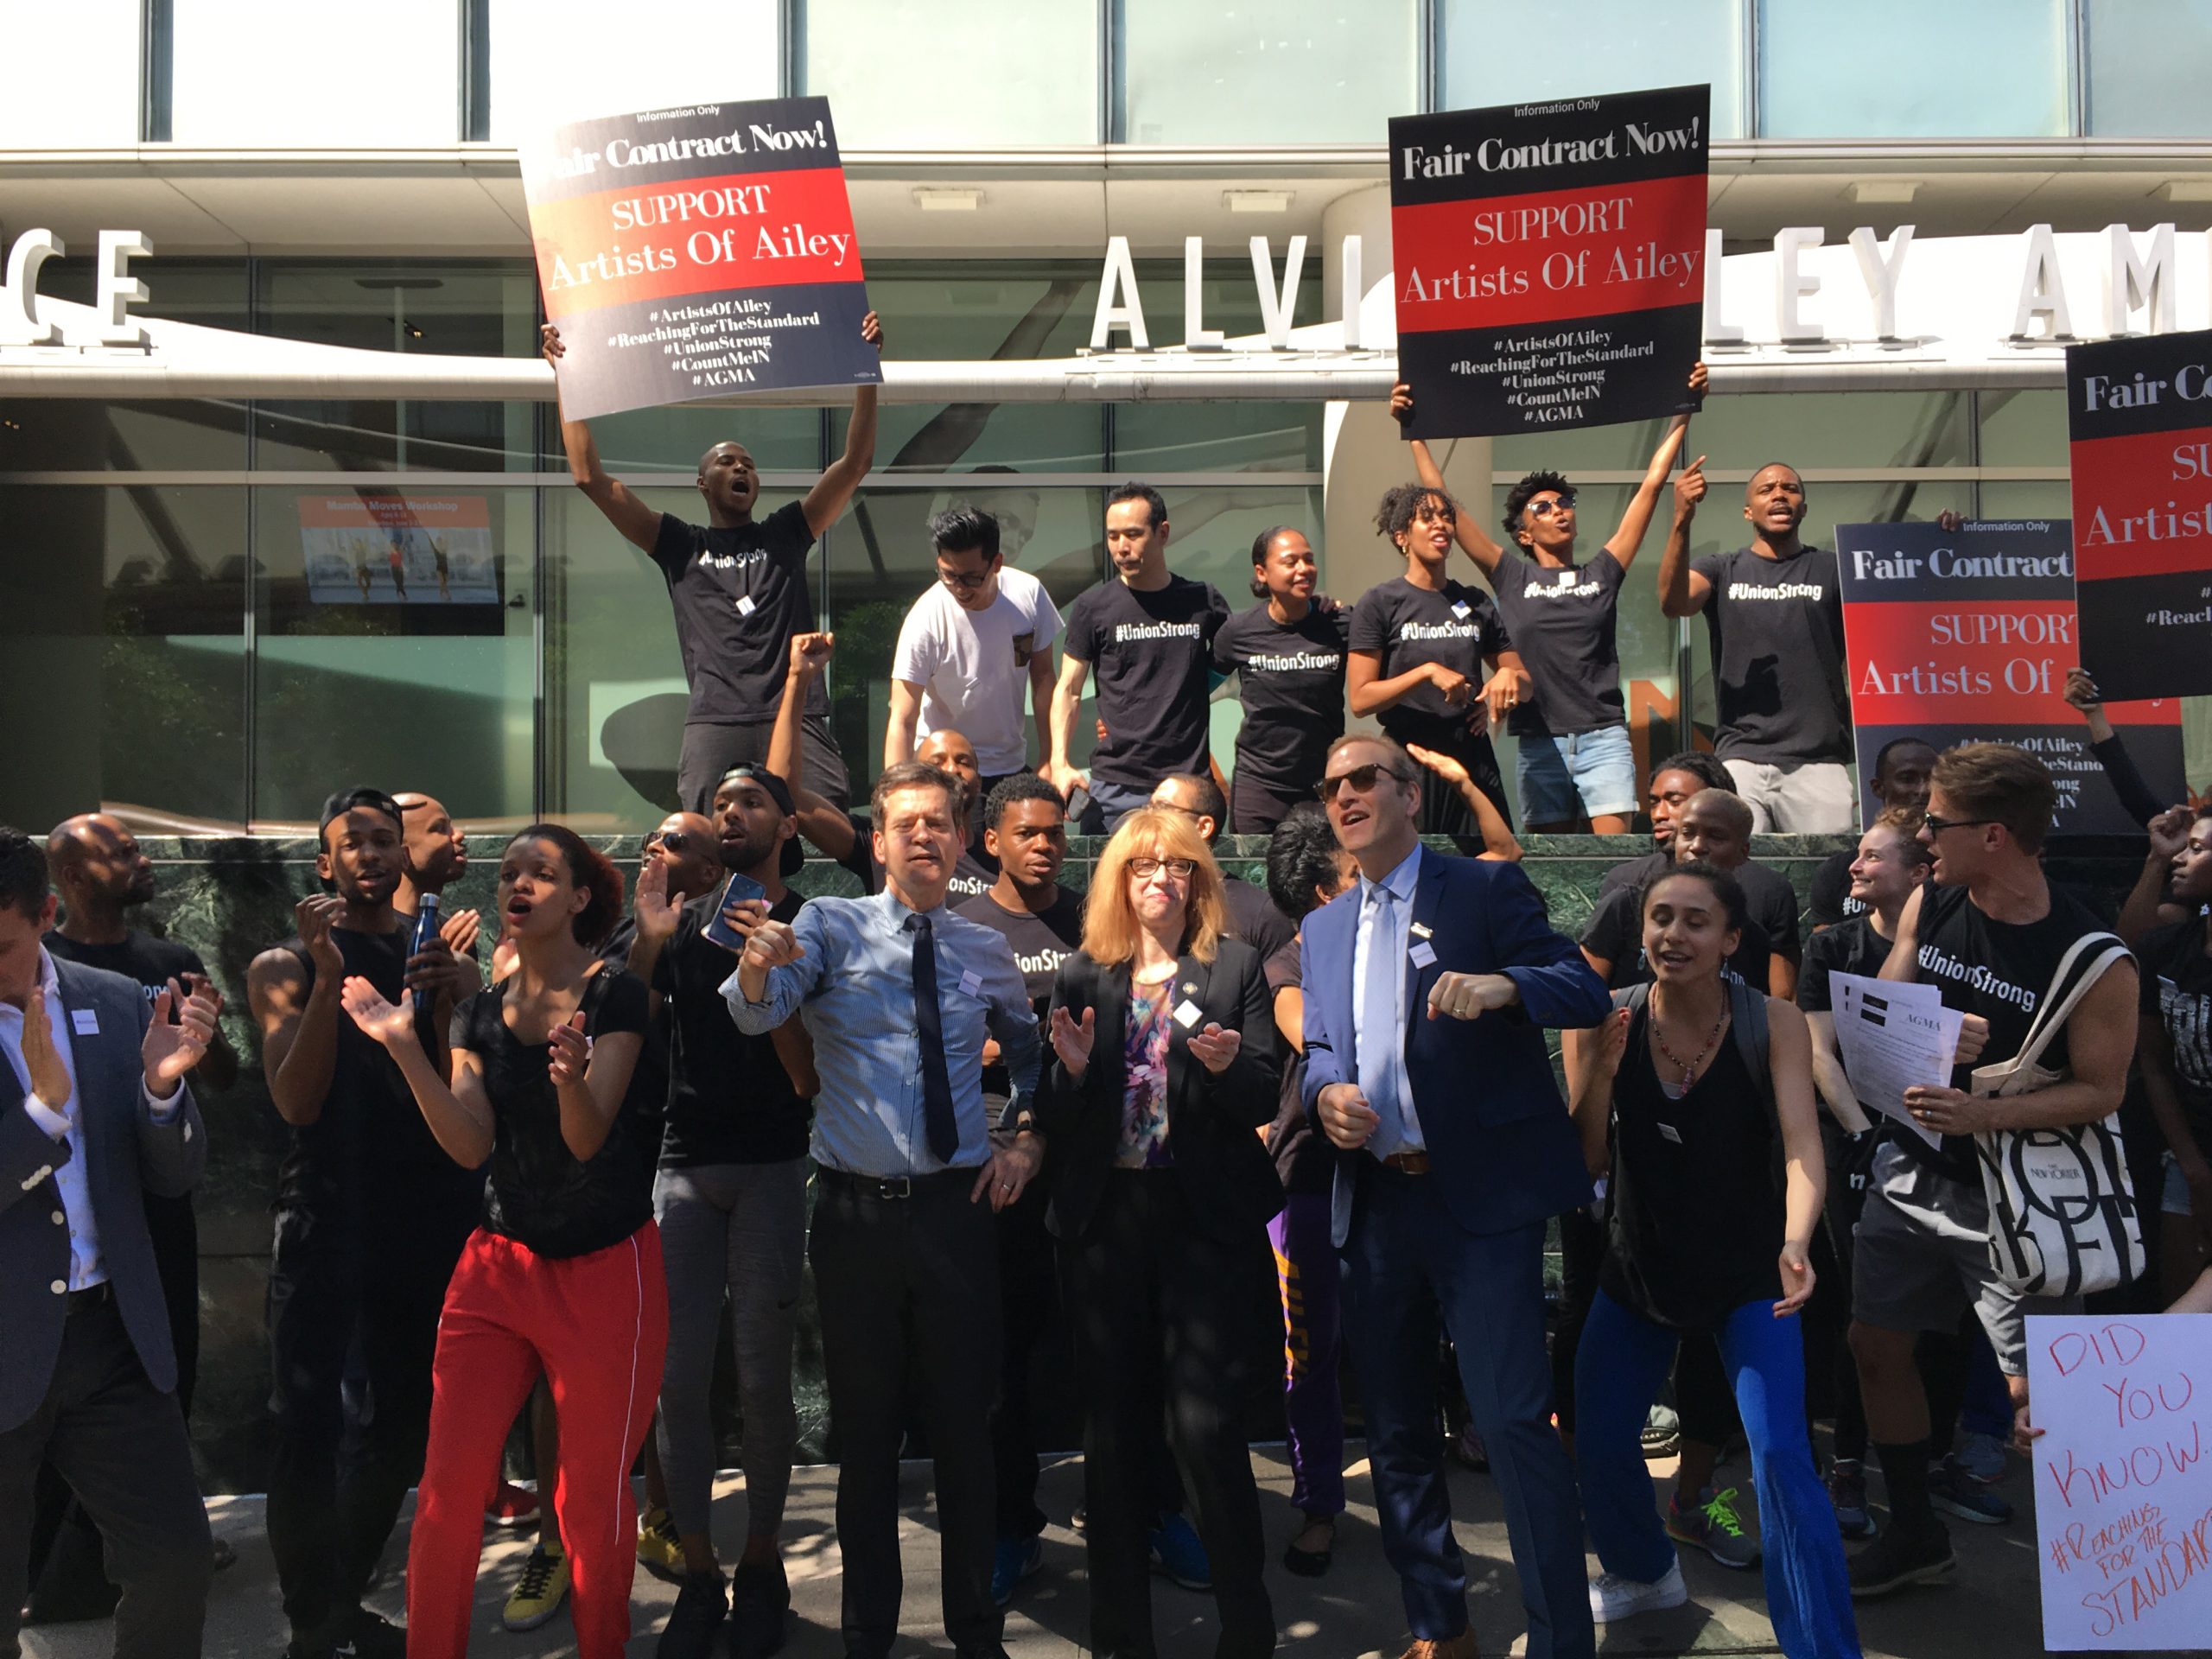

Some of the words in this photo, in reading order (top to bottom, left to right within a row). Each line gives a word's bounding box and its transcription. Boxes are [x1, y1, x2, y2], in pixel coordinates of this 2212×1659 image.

[636, 105, 696, 123] Information
[696, 104, 720, 118] Only
[1514, 100, 1575, 118] Information
[1577, 98, 1600, 113] Only
[544, 146, 601, 180] air
[606, 127, 747, 168] Contract
[749, 120, 829, 154] Now!
[1402, 143, 1471, 181] Fair
[1477, 130, 1619, 174] Contract
[1625, 115, 1700, 158] Now!
[610, 184, 771, 231] SUPPORT
[1473, 197, 1634, 245] SUPPORT
[548, 245, 677, 292] Artists
[686, 228, 735, 265] Of
[751, 223, 851, 266] Ailey
[1400, 263, 1529, 303] Artists
[1542, 249, 1591, 290] Of
[1601, 241, 1701, 288] Ailey
[1090, 234, 1362, 350] ALVI
[1703, 225, 1916, 345] LEY
[2010, 222, 2212, 340] AM
[649, 299, 772, 322] #ArtistsOfAiley
[607, 312, 820, 349] #ReachingForTheStandard
[664, 335, 772, 357] #UnionStrong
[1494, 329, 1612, 353] #ArtistsOfAiley
[671, 349, 771, 372] #CountMeIN
[1450, 341, 1654, 375] #ReachingForTheStandard
[692, 368, 756, 387] #AGMA
[1501, 369, 1605, 389] #UnionStrong
[2083, 371, 2168, 412] Fair
[1506, 385, 1601, 407] #CountMeIN
[1523, 408, 1584, 423] #AGMA
[369, 500, 403, 511] Moves
[405, 500, 458, 512] Workshop
[1962, 520, 2024, 533] Information
[2026, 520, 2050, 534] Only
[1852, 550, 1923, 581] Fair
[1929, 547, 2074, 578] Contract
[1728, 582, 1822, 601] #UnionStrong
[1115, 620, 1200, 643] #UnionStrong
[1248, 652, 1340, 672] #UnionStrong
[1858, 659, 1993, 696] Artists
[2004, 658, 2054, 695] Of
[1917, 942, 2037, 1014] #UnionStrong
[1906, 1014, 1942, 1032] AGMA
[2049, 1323, 2145, 1377] DID
[2102, 1372, 2193, 1428] YOU
[2095, 1544, 2138, 1580] FOR
[2137, 1516, 2168, 1554] THE
[2081, 1507, 2212, 1637] STANDAR
